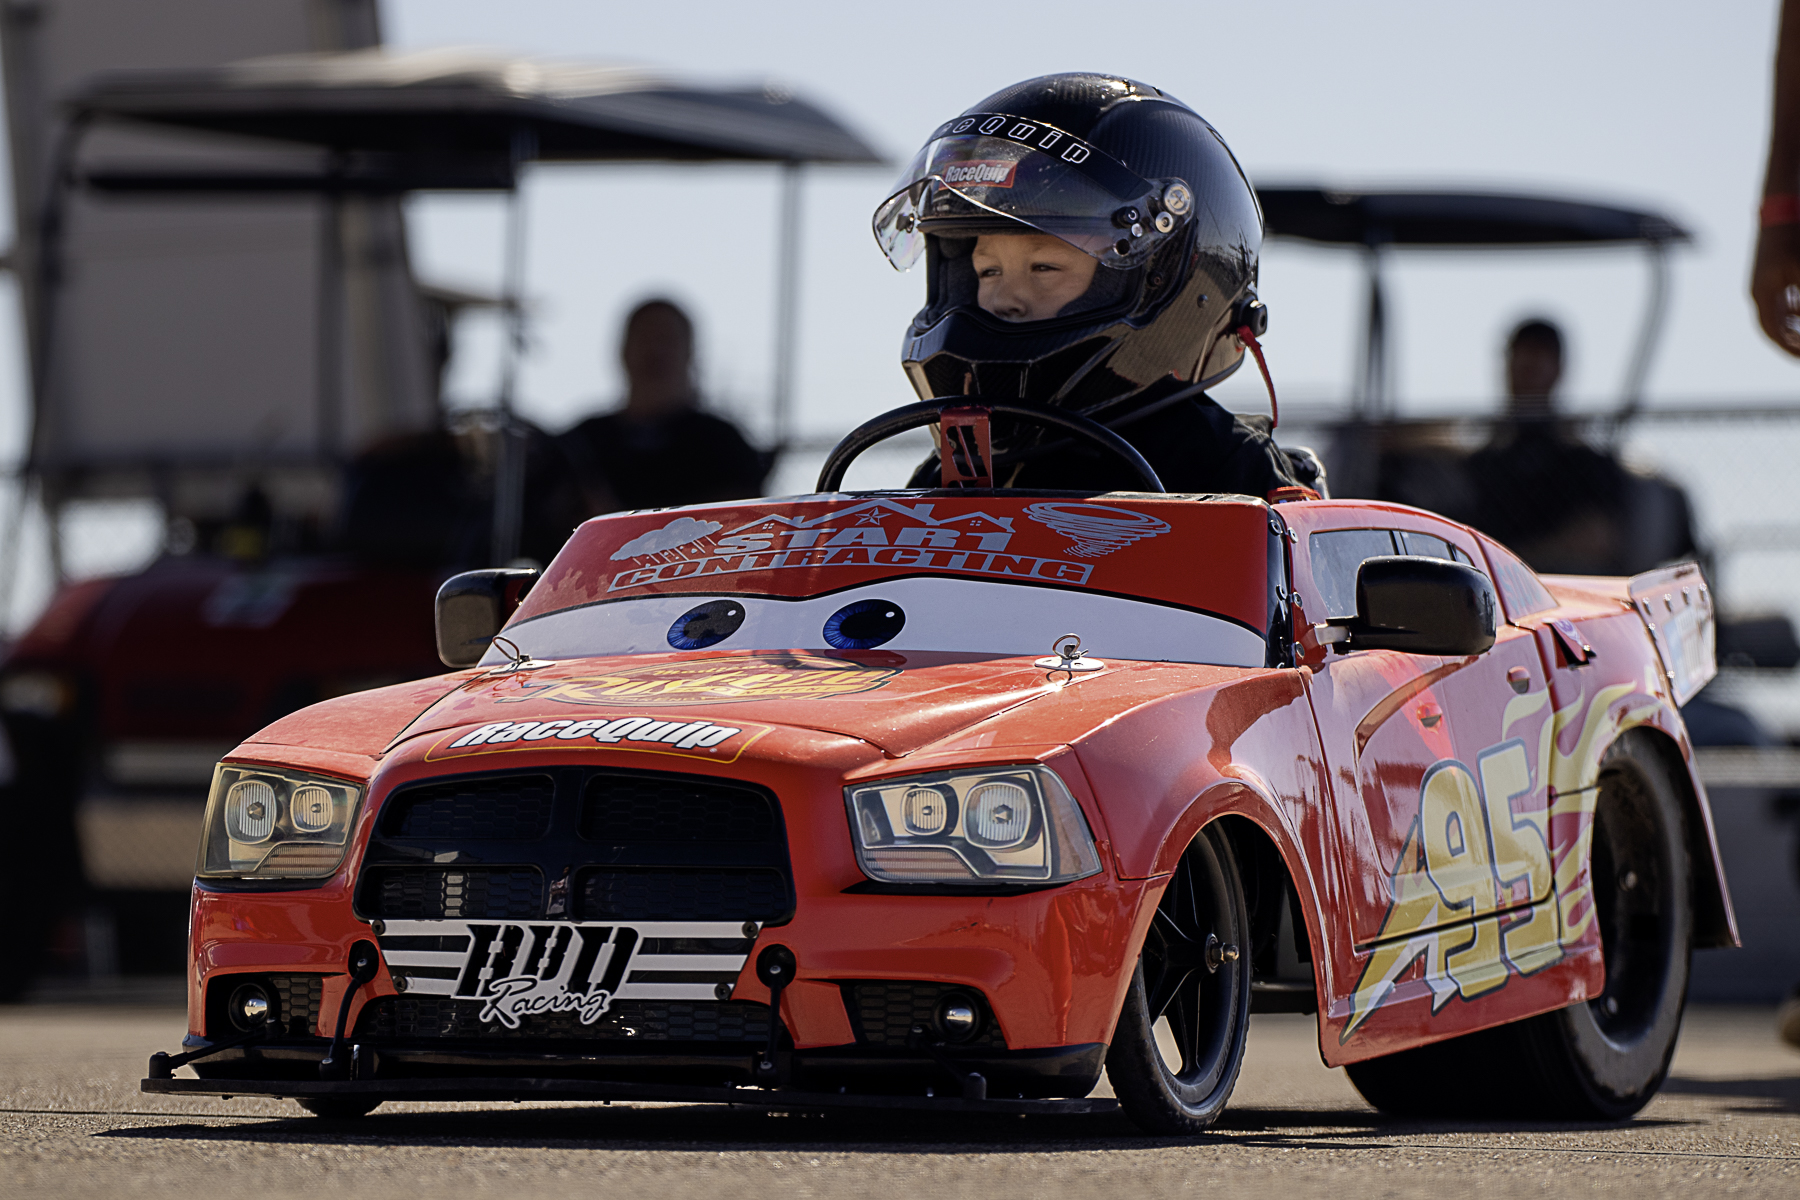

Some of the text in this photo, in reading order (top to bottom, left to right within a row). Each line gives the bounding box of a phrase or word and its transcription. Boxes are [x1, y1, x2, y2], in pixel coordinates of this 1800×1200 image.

[945, 163, 1011, 184] RaceQuip
[612, 547, 1089, 589] CONTRACTING
[447, 717, 743, 750] RaceQuip
[1419, 736, 1566, 1002] 95
[480, 976, 607, 1027] Racing
